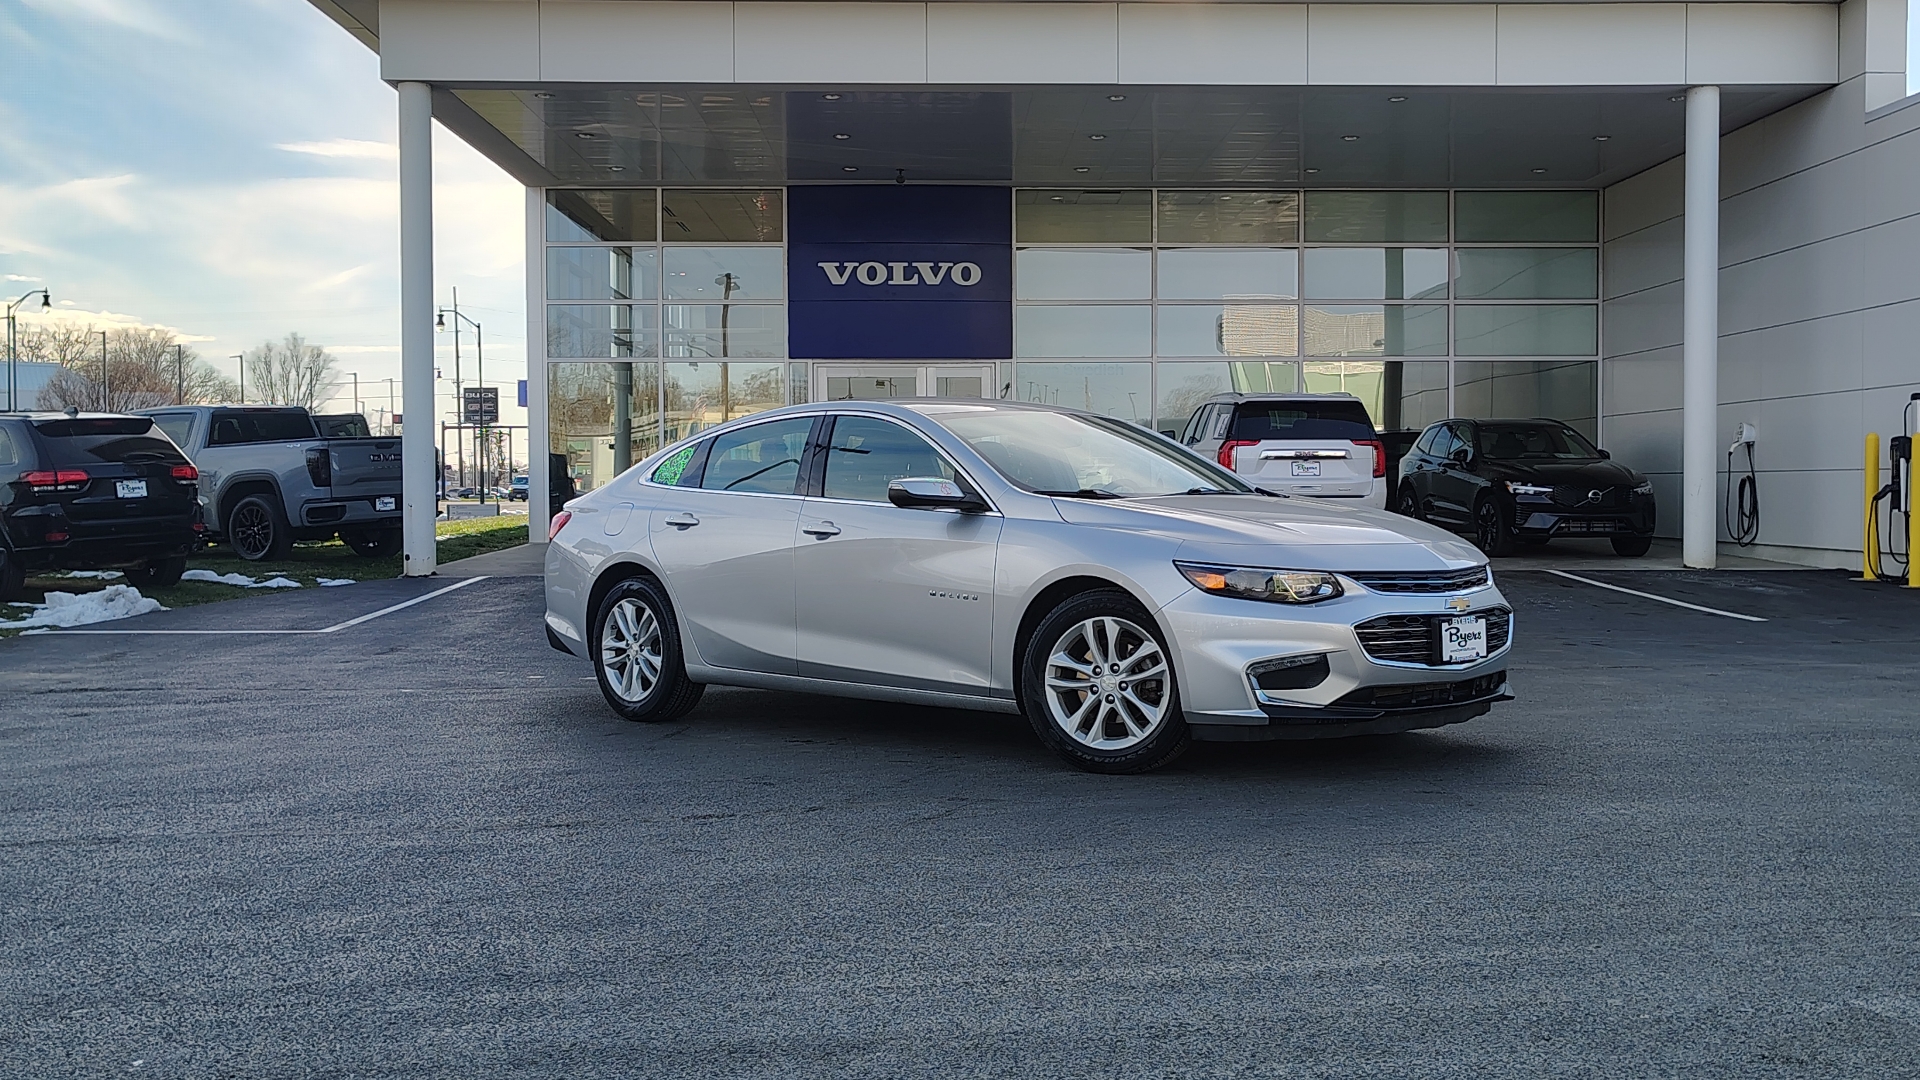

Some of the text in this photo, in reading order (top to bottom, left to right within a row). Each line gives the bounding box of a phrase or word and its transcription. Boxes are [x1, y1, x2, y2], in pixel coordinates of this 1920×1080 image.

[817, 262, 982, 286] VOLVO
[1064, 363, 1124, 376] Swedish
[1453, 616, 1477, 625] BYERS
[1445, 627, 1482, 648] Byers
